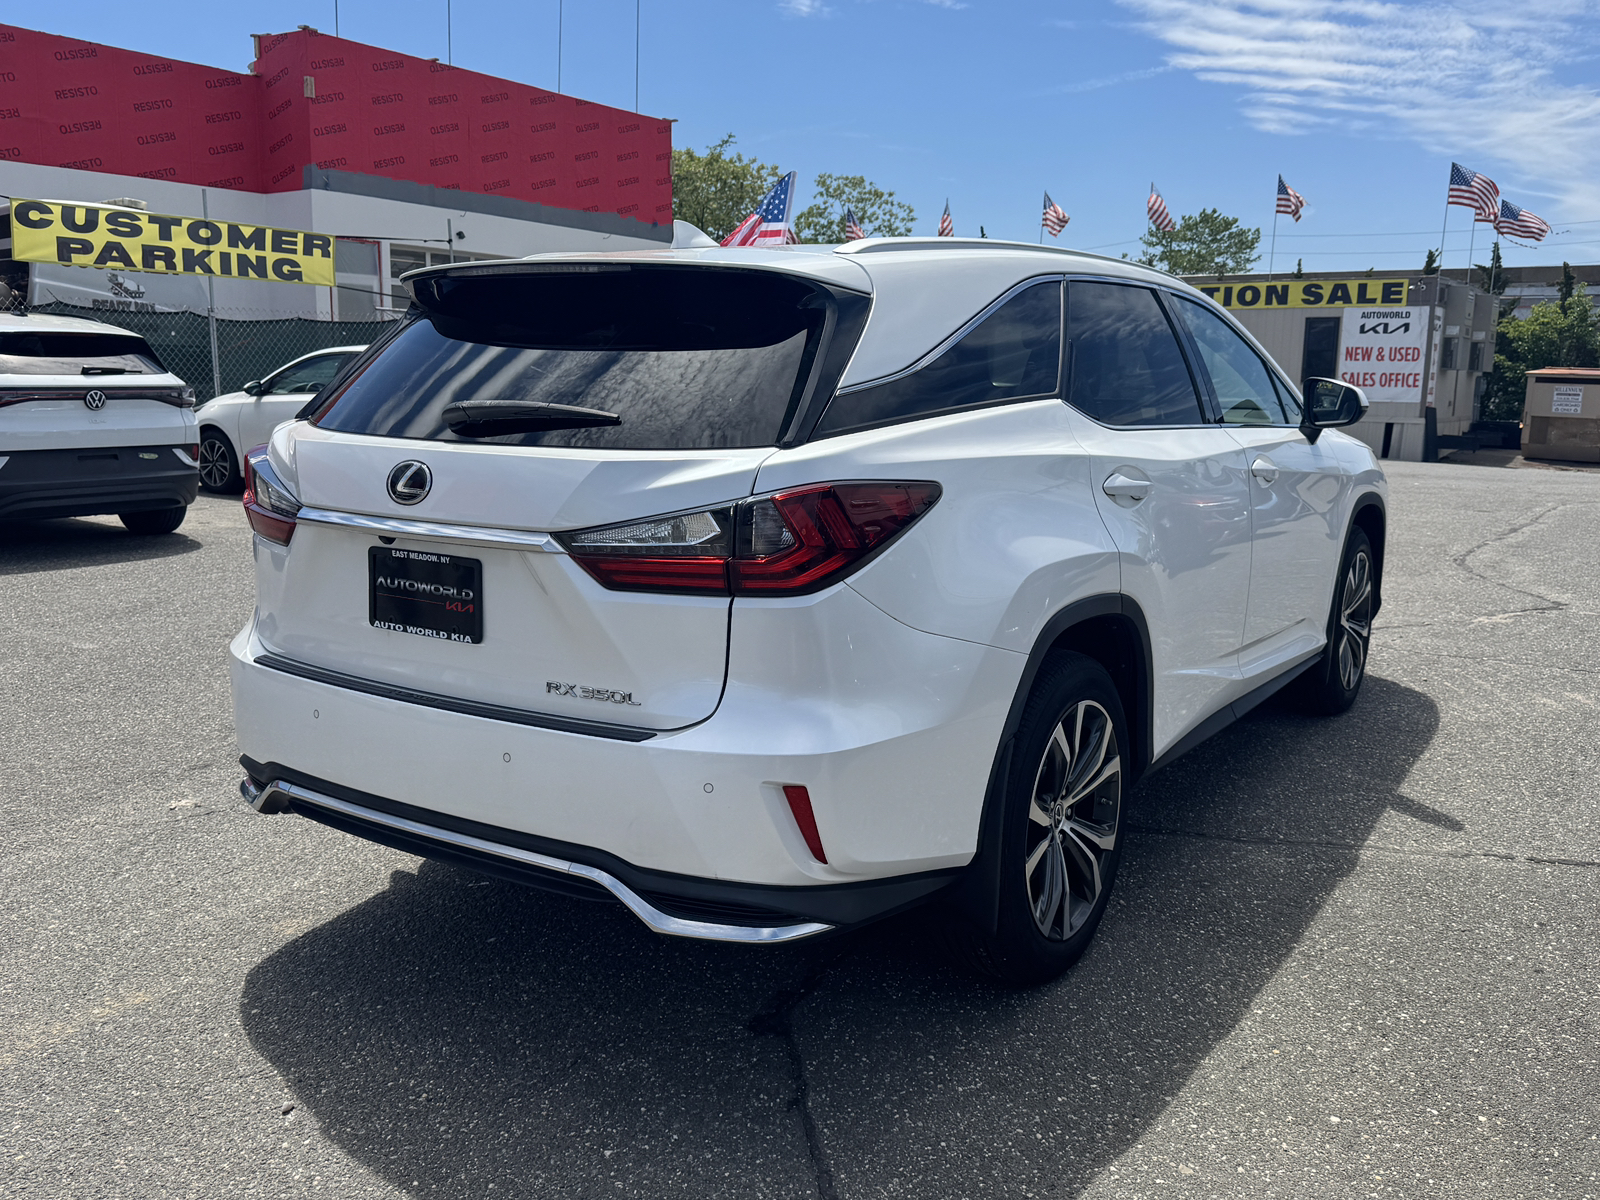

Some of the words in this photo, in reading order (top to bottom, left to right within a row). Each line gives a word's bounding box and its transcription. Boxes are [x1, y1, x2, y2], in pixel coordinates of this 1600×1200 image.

[54, 48, 98, 61] RESISTO
[133, 63, 173, 75] RESISTO
[311, 57, 345, 70] RESISTO
[372, 60, 404, 72] RESISTO
[205, 76, 242, 89] RESISTO
[265, 67, 289, 89] RESISTO
[54, 86, 98, 100] RESISTO
[371, 93, 404, 105] RESISTO
[481, 92, 509, 104] RESISTO
[133, 99, 173, 112] RESISTO
[428, 94, 458, 106] RESISTO
[529, 95, 556, 106] RESISTO
[268, 98, 292, 120] RESISTO
[205, 111, 242, 124] RESISTO
[59, 120, 102, 135] RESISTO
[313, 123, 347, 137] RESISTO
[373, 123, 406, 136] RESISTO
[430, 123, 460, 135] RESISTO
[482, 121, 510, 133] RESISTO
[531, 122, 557, 134] RESISTO
[575, 122, 600, 133] RESISTO
[617, 123, 640, 134] RESISTO
[137, 132, 176, 146] RESISTO
[269, 133, 293, 155] RESISTO
[208, 142, 244, 156] RESISTO
[373, 156, 405, 169] RESISTO
[429, 155, 459, 167] RESISTO
[481, 151, 509, 163] RESISTO
[529, 151, 555, 163] RESISTO
[574, 150, 599, 162] RESISTO
[616, 151, 639, 163] RESISTO
[316, 157, 347, 170] ESISTO
[272, 163, 296, 184] RESISTO
[483, 179, 511, 192] RESISTO
[531, 178, 557, 190] RESISTO
[575, 177, 600, 188] RESISTO
[617, 176, 640, 188] RESISTO
[616, 203, 639, 214] RESISTO
[14, 201, 331, 258] CUSTOMER
[56, 236, 303, 282] PARKING
[1300, 282, 1405, 305] SALE
[1360, 311, 1411, 319] AUTOWORLD
[1359, 322, 1410, 334] KIA
[1345, 346, 1373, 361] NEW
[1376, 346, 1385, 362] &
[1389, 346, 1420, 362] USED
[1341, 372, 1376, 387] SALES
[1379, 372, 1420, 388] OFFICE
[391, 550, 408, 558] EAST
[440, 556, 451, 564] NY
[376, 575, 474, 600] AUTOWORLD
[445, 601, 474, 613] KIA
[373, 620, 404, 632] AUTO
[406, 625, 447, 639] WORLD
[451, 633, 473, 643] KIA
